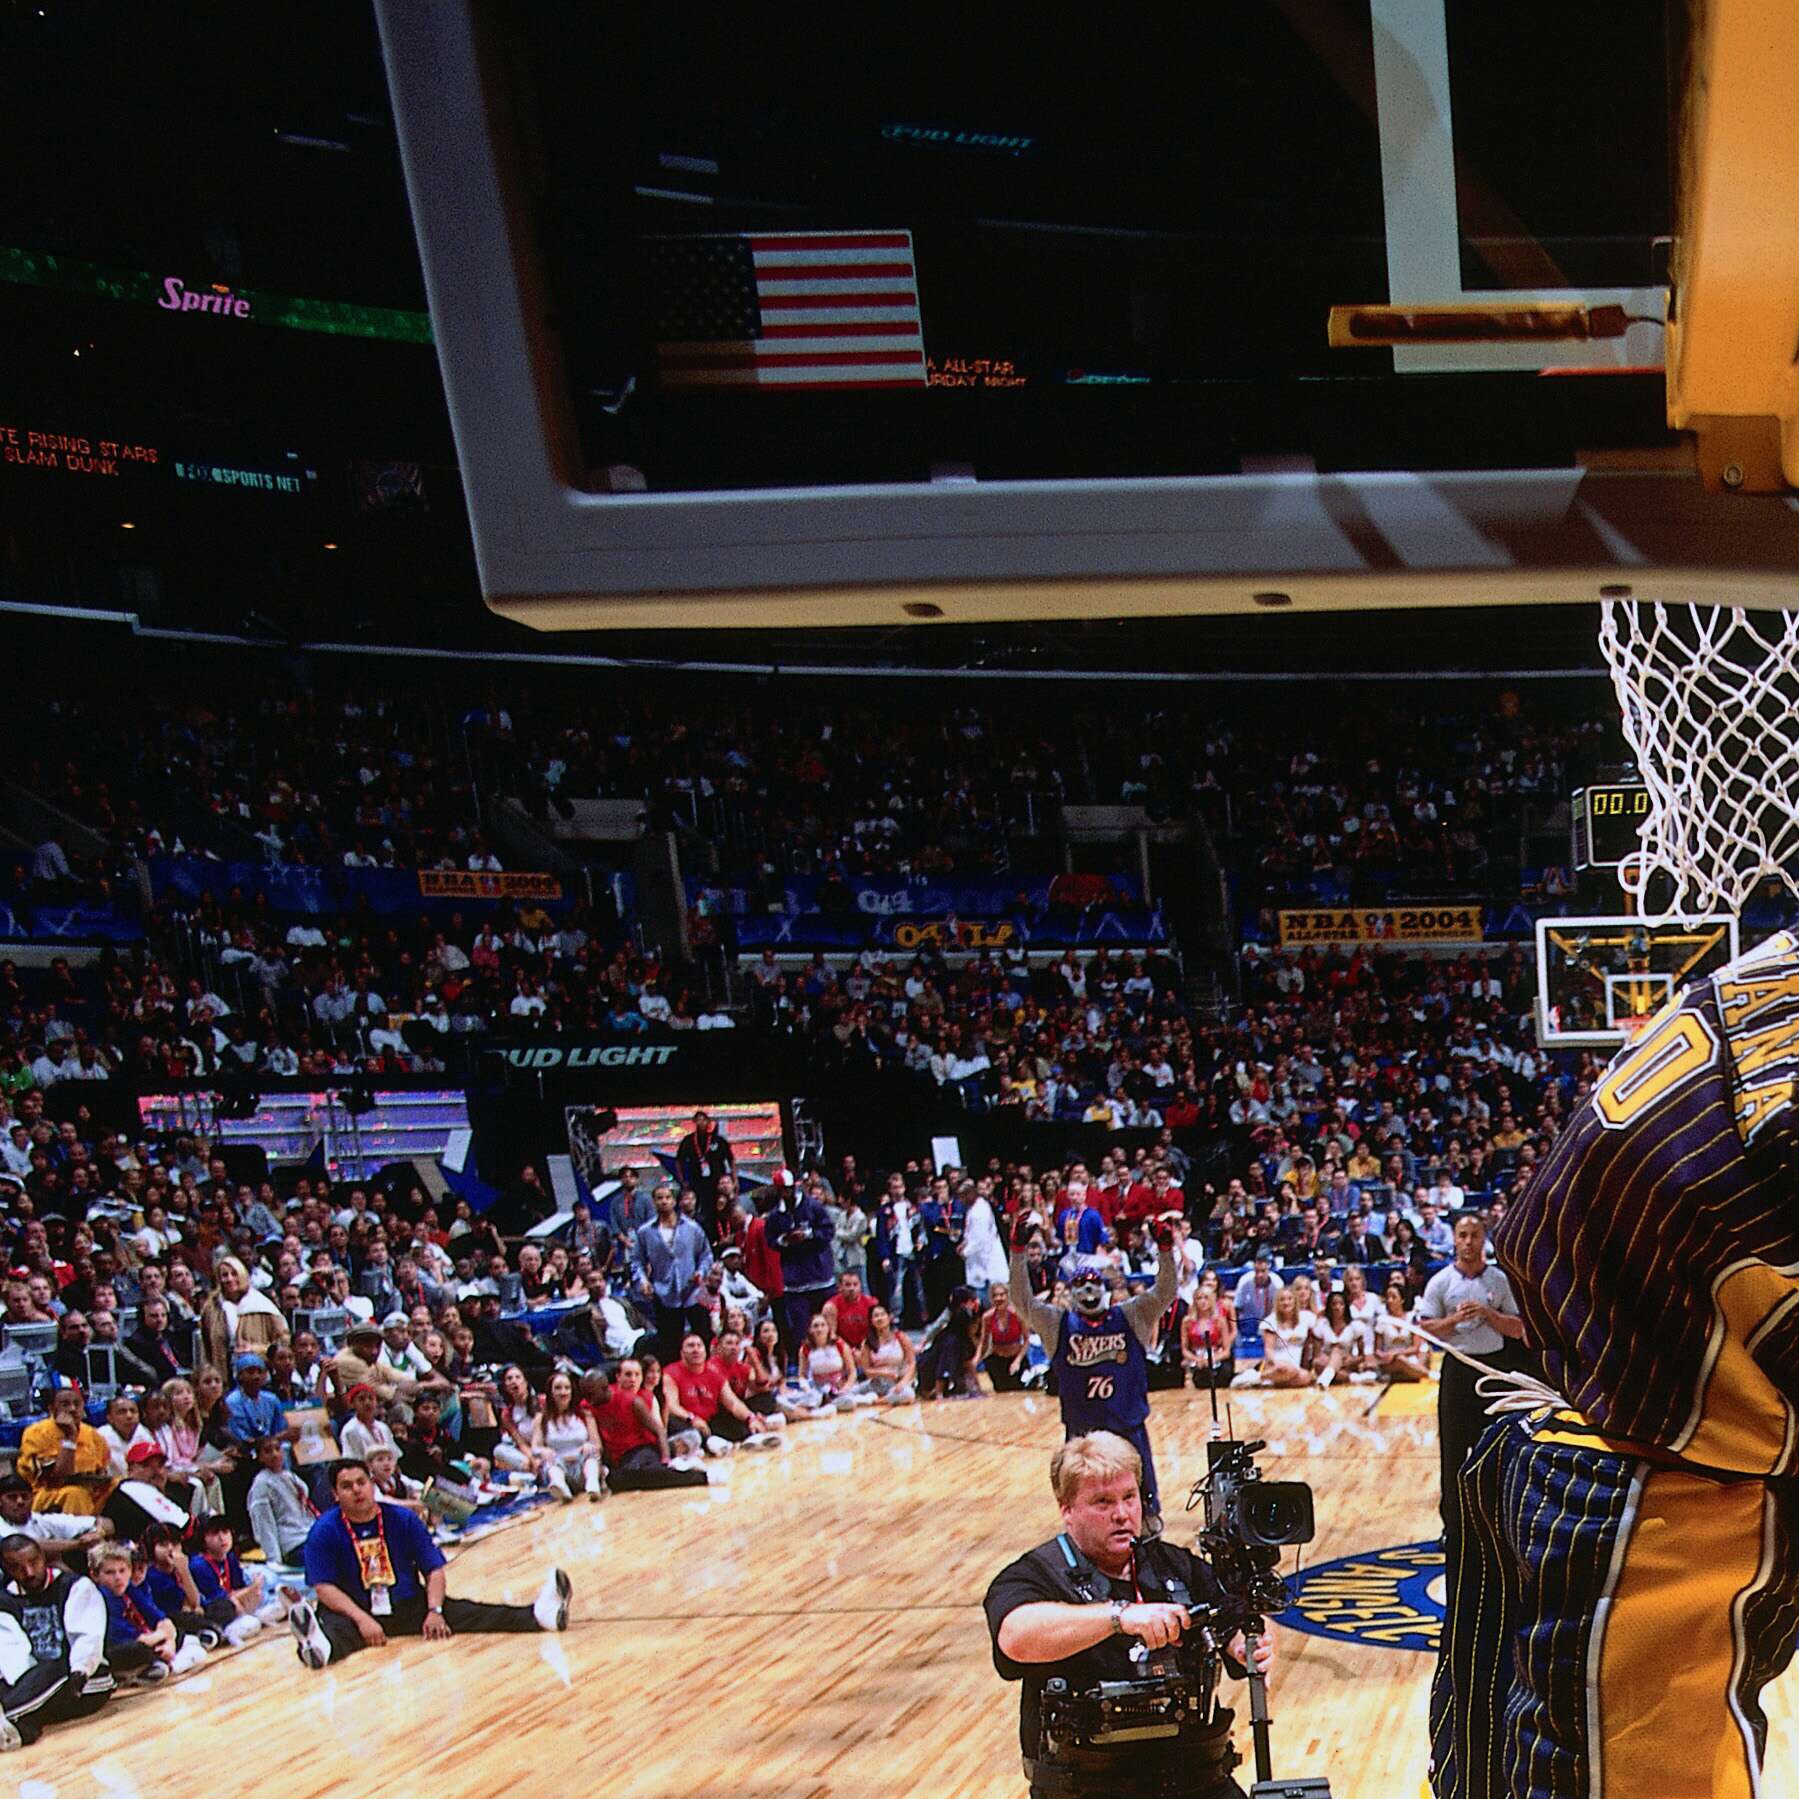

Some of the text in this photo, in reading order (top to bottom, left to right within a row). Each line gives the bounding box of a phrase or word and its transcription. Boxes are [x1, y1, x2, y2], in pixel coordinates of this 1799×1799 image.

[158, 277, 251, 318] Sprite
[4, 446, 119, 477] SLAM DUNK
[28, 431, 89, 454] RISING
[99, 441, 160, 464] STARS
[221, 466, 274, 491] SPORTS
[276, 474, 302, 494] NET
[1286, 913, 1359, 929] NBA
[1400, 910, 1472, 929] 2004
[566, 1045, 680, 1067] LIGHT
[1086, 1375, 1114, 1399] 76
